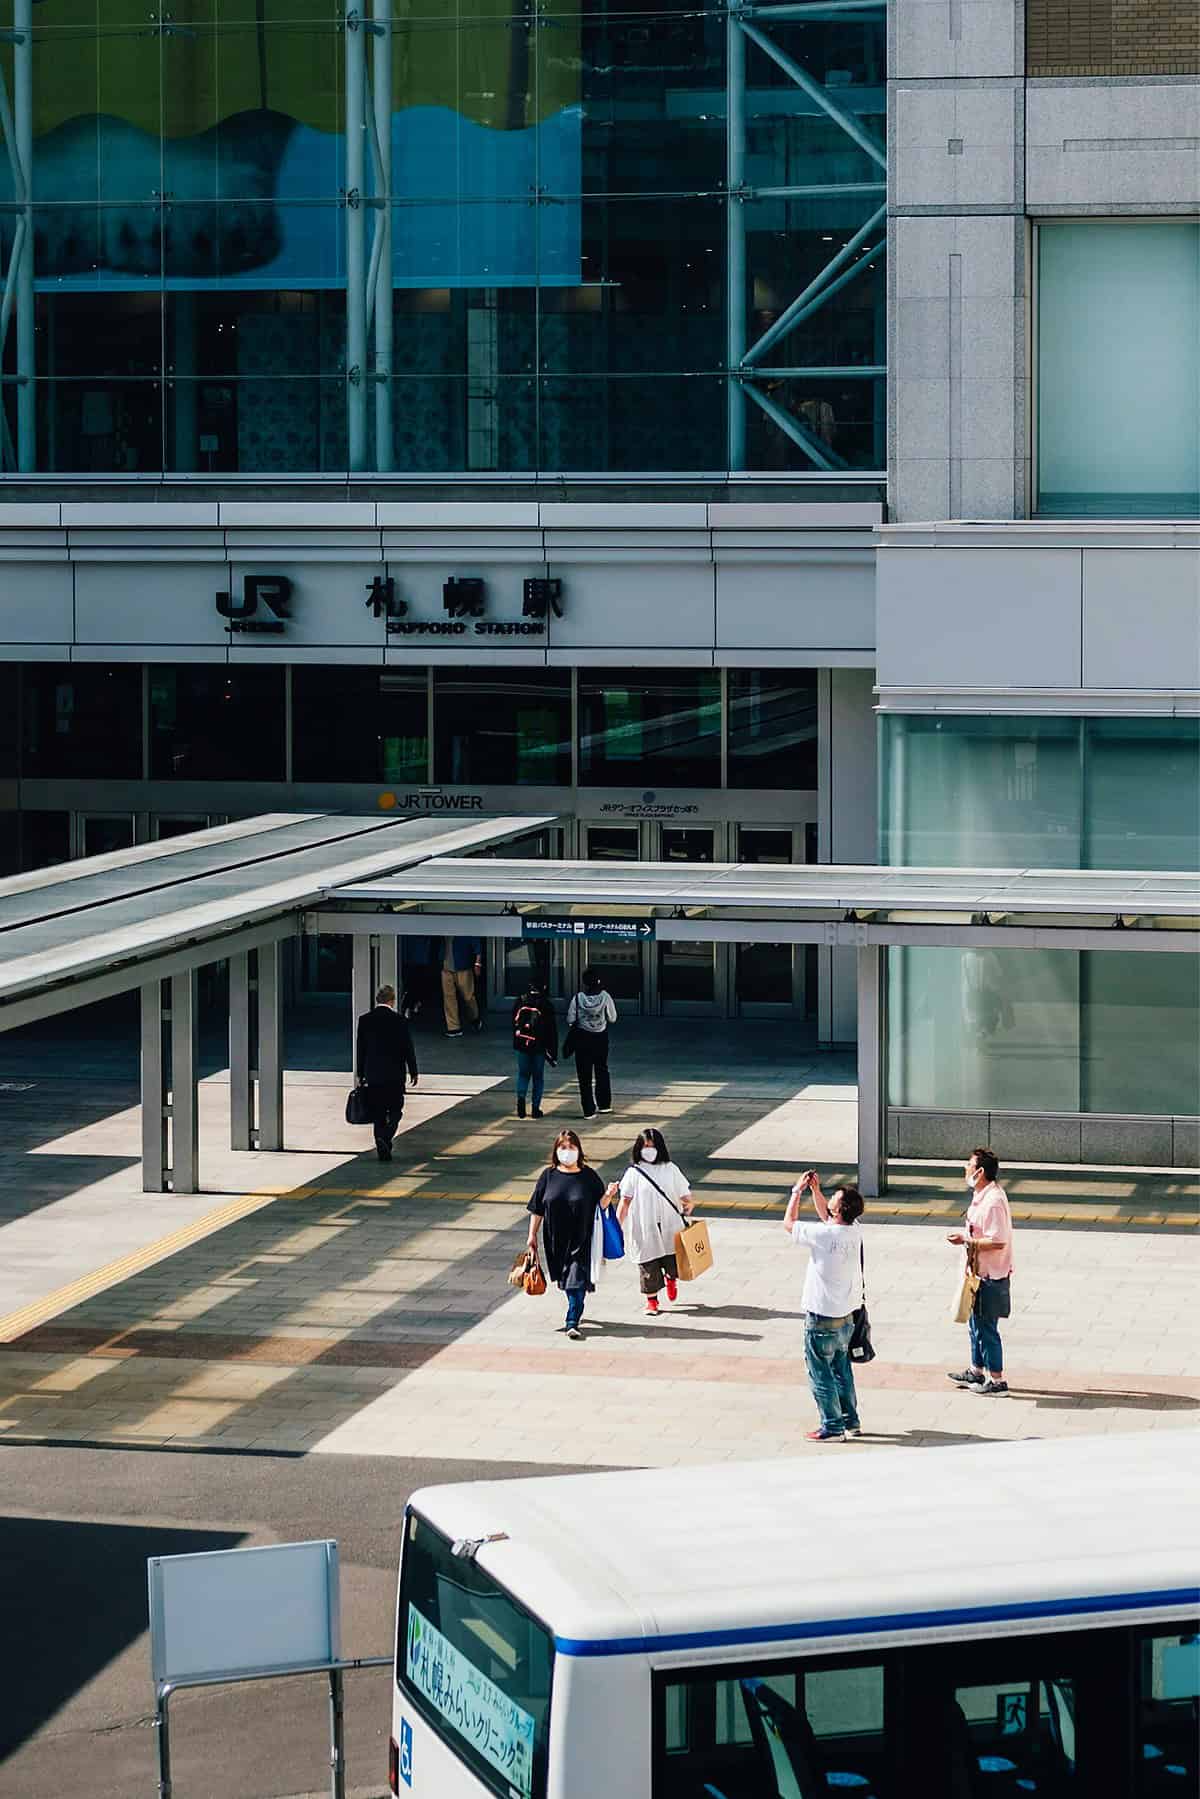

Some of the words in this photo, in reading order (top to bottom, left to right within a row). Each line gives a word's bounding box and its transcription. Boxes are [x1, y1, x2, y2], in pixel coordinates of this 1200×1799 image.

[216, 575, 294, 618] JR
[366, 576, 564, 618] 札幌駅
[385, 622, 465, 634] SAPPORO
[474, 622, 546, 634] STATION
[398, 795, 420, 809] JR
[421, 796, 483, 810] TOWER
[695, 1240, 704, 1253] GU
[420, 1650, 517, 1768] 札幌みらいクリニック
